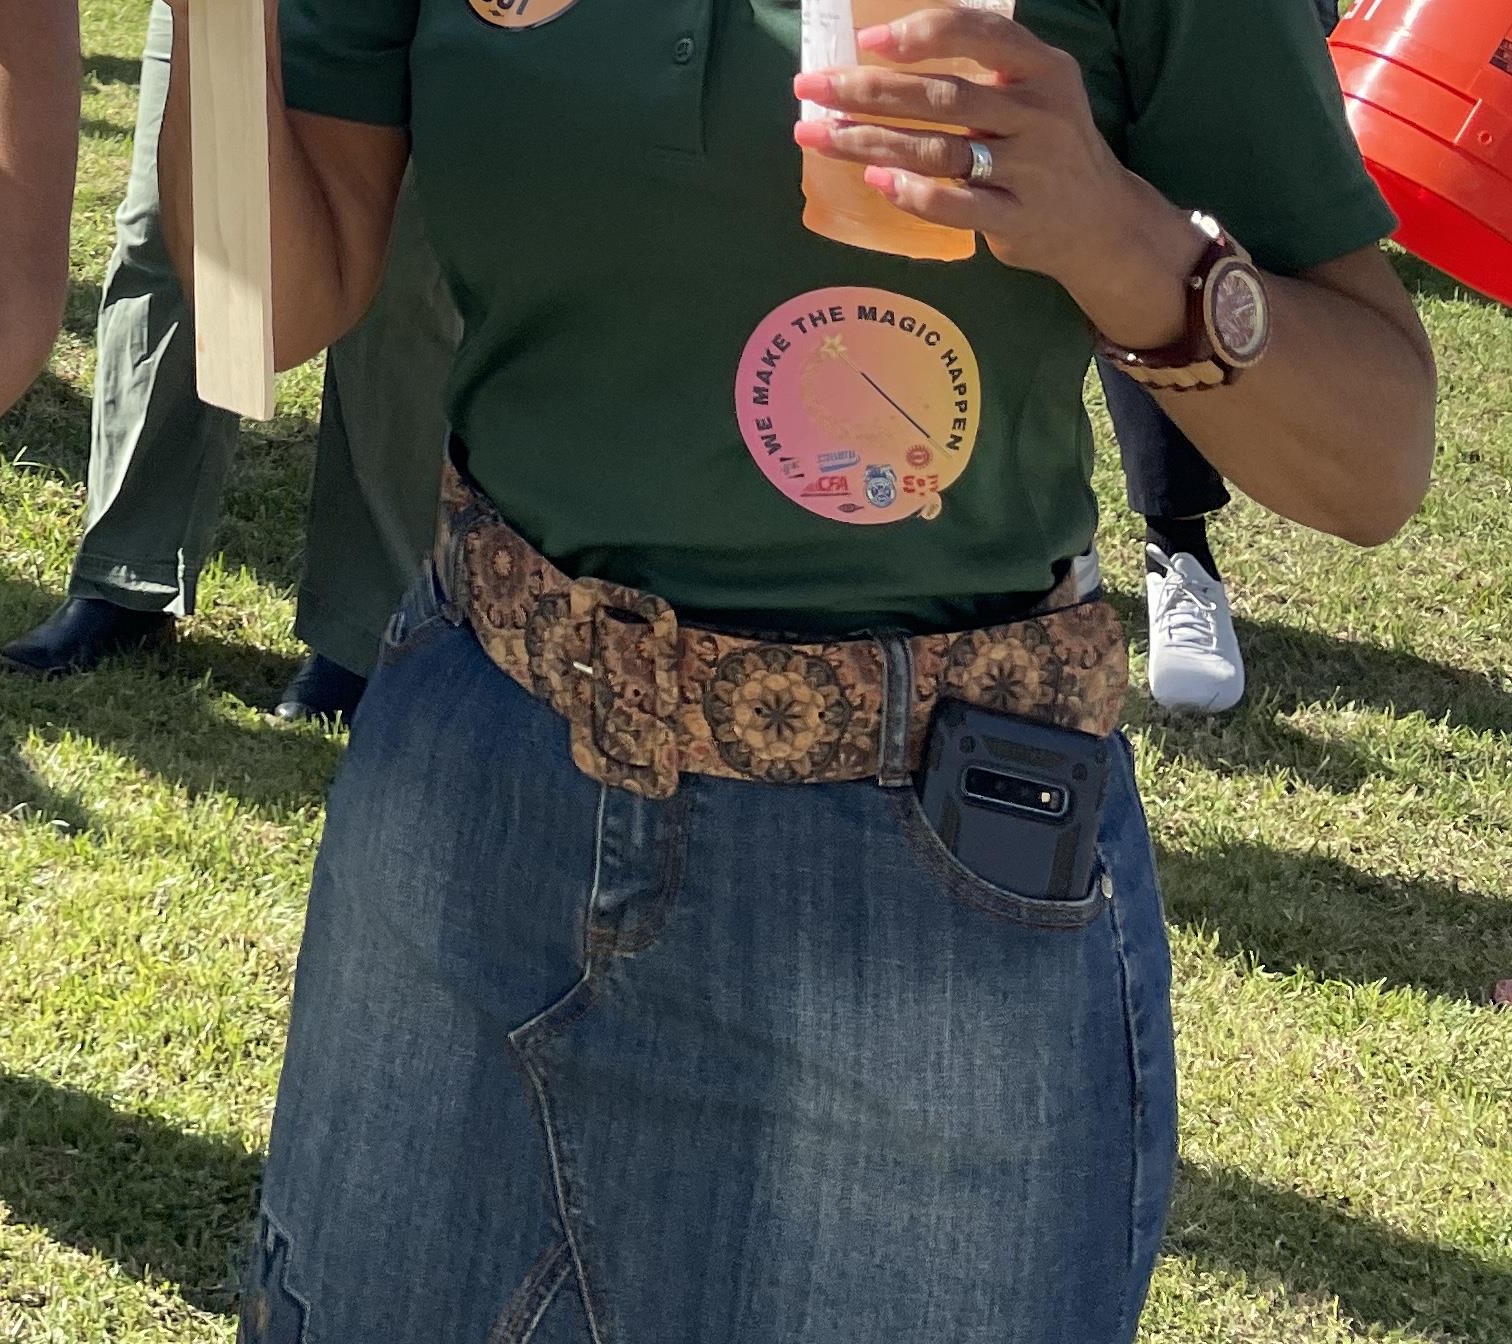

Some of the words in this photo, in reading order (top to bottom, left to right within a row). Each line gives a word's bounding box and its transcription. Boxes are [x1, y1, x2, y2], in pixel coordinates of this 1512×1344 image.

[791, 306, 845, 334] THE
[857, 305, 941, 346] MAGIC
[752, 333, 791, 405] MAKE
[940, 349, 968, 451] HAPPEN
[755, 416, 782, 456] WE
